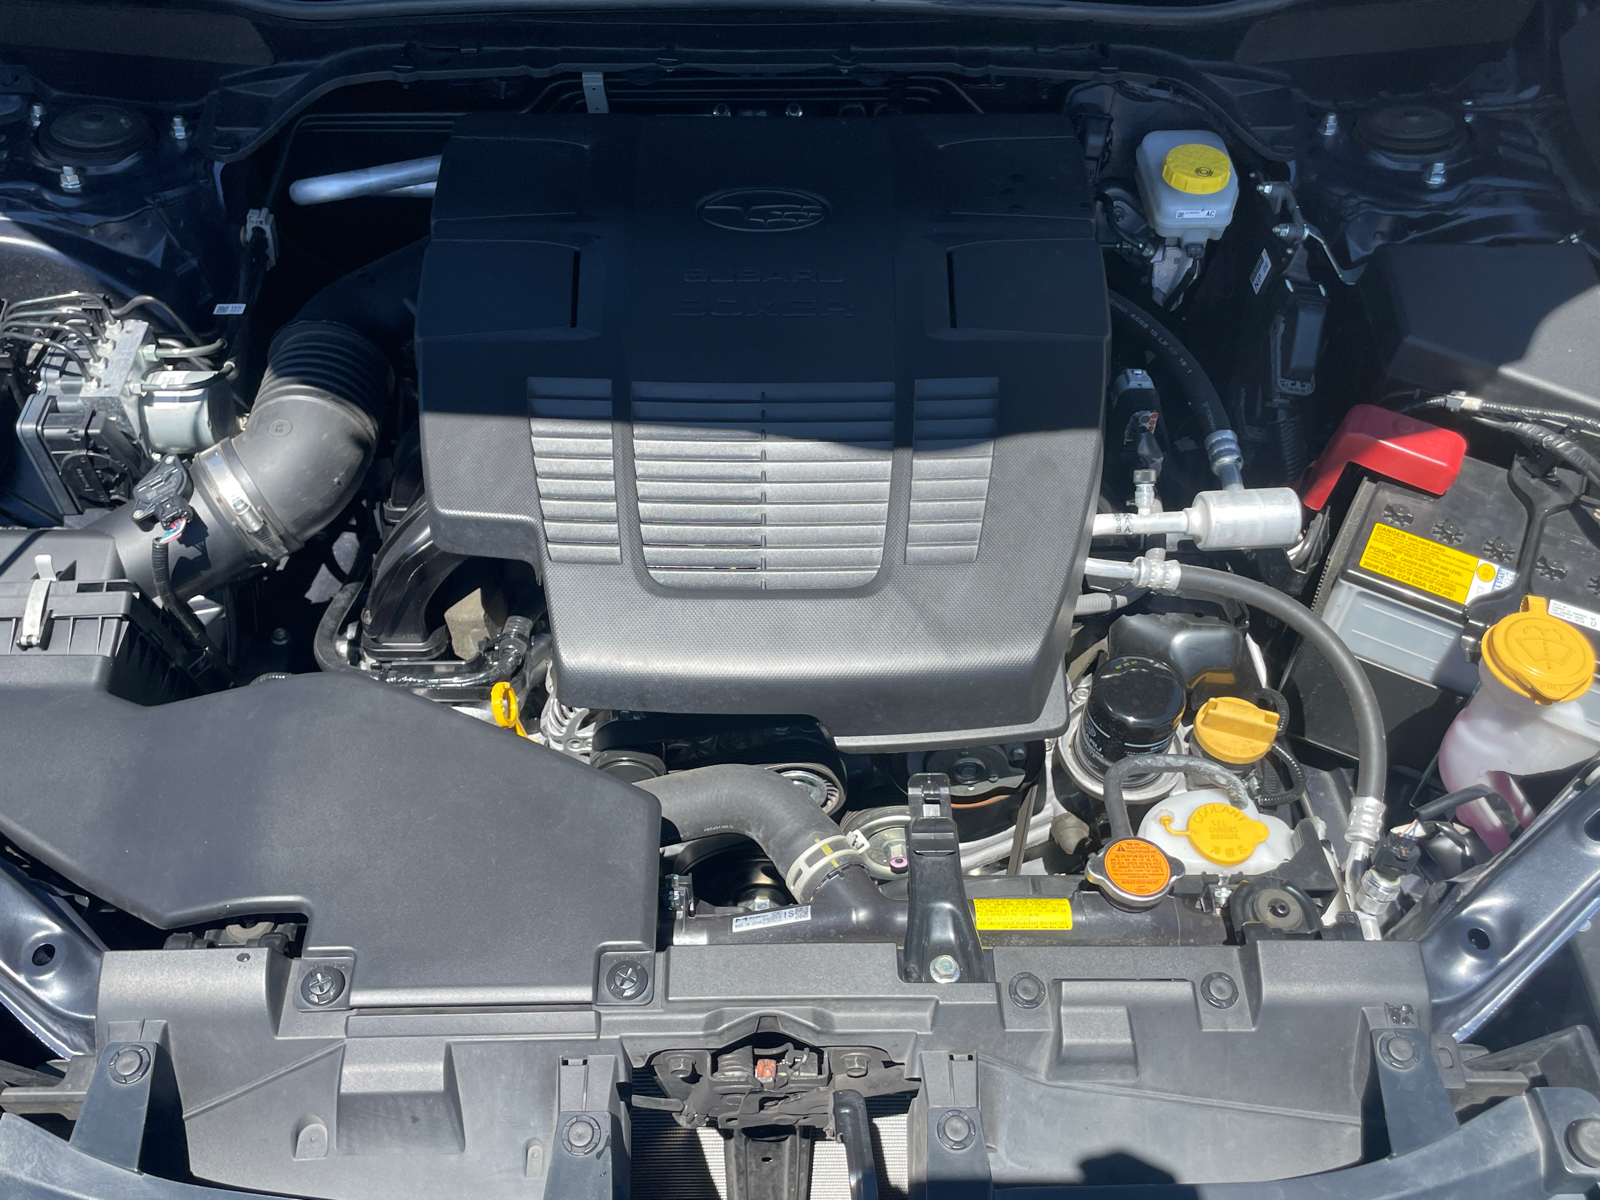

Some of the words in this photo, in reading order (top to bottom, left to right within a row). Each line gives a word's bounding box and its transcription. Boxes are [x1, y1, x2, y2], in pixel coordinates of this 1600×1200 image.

[683, 268, 845, 284] SUBARU
[672, 298, 855, 317] BOXER
[1376, 525, 1406, 538] DANGER
[1368, 545, 1396, 558] POISON
[1363, 560, 1379, 570] 20HR
[1379, 566, 1394, 575] 62Ah
[1397, 573, 1410, 581] CCA
[1540, 682, 1566, 693] PULL
[1192, 805, 1248, 823] COOLANT
